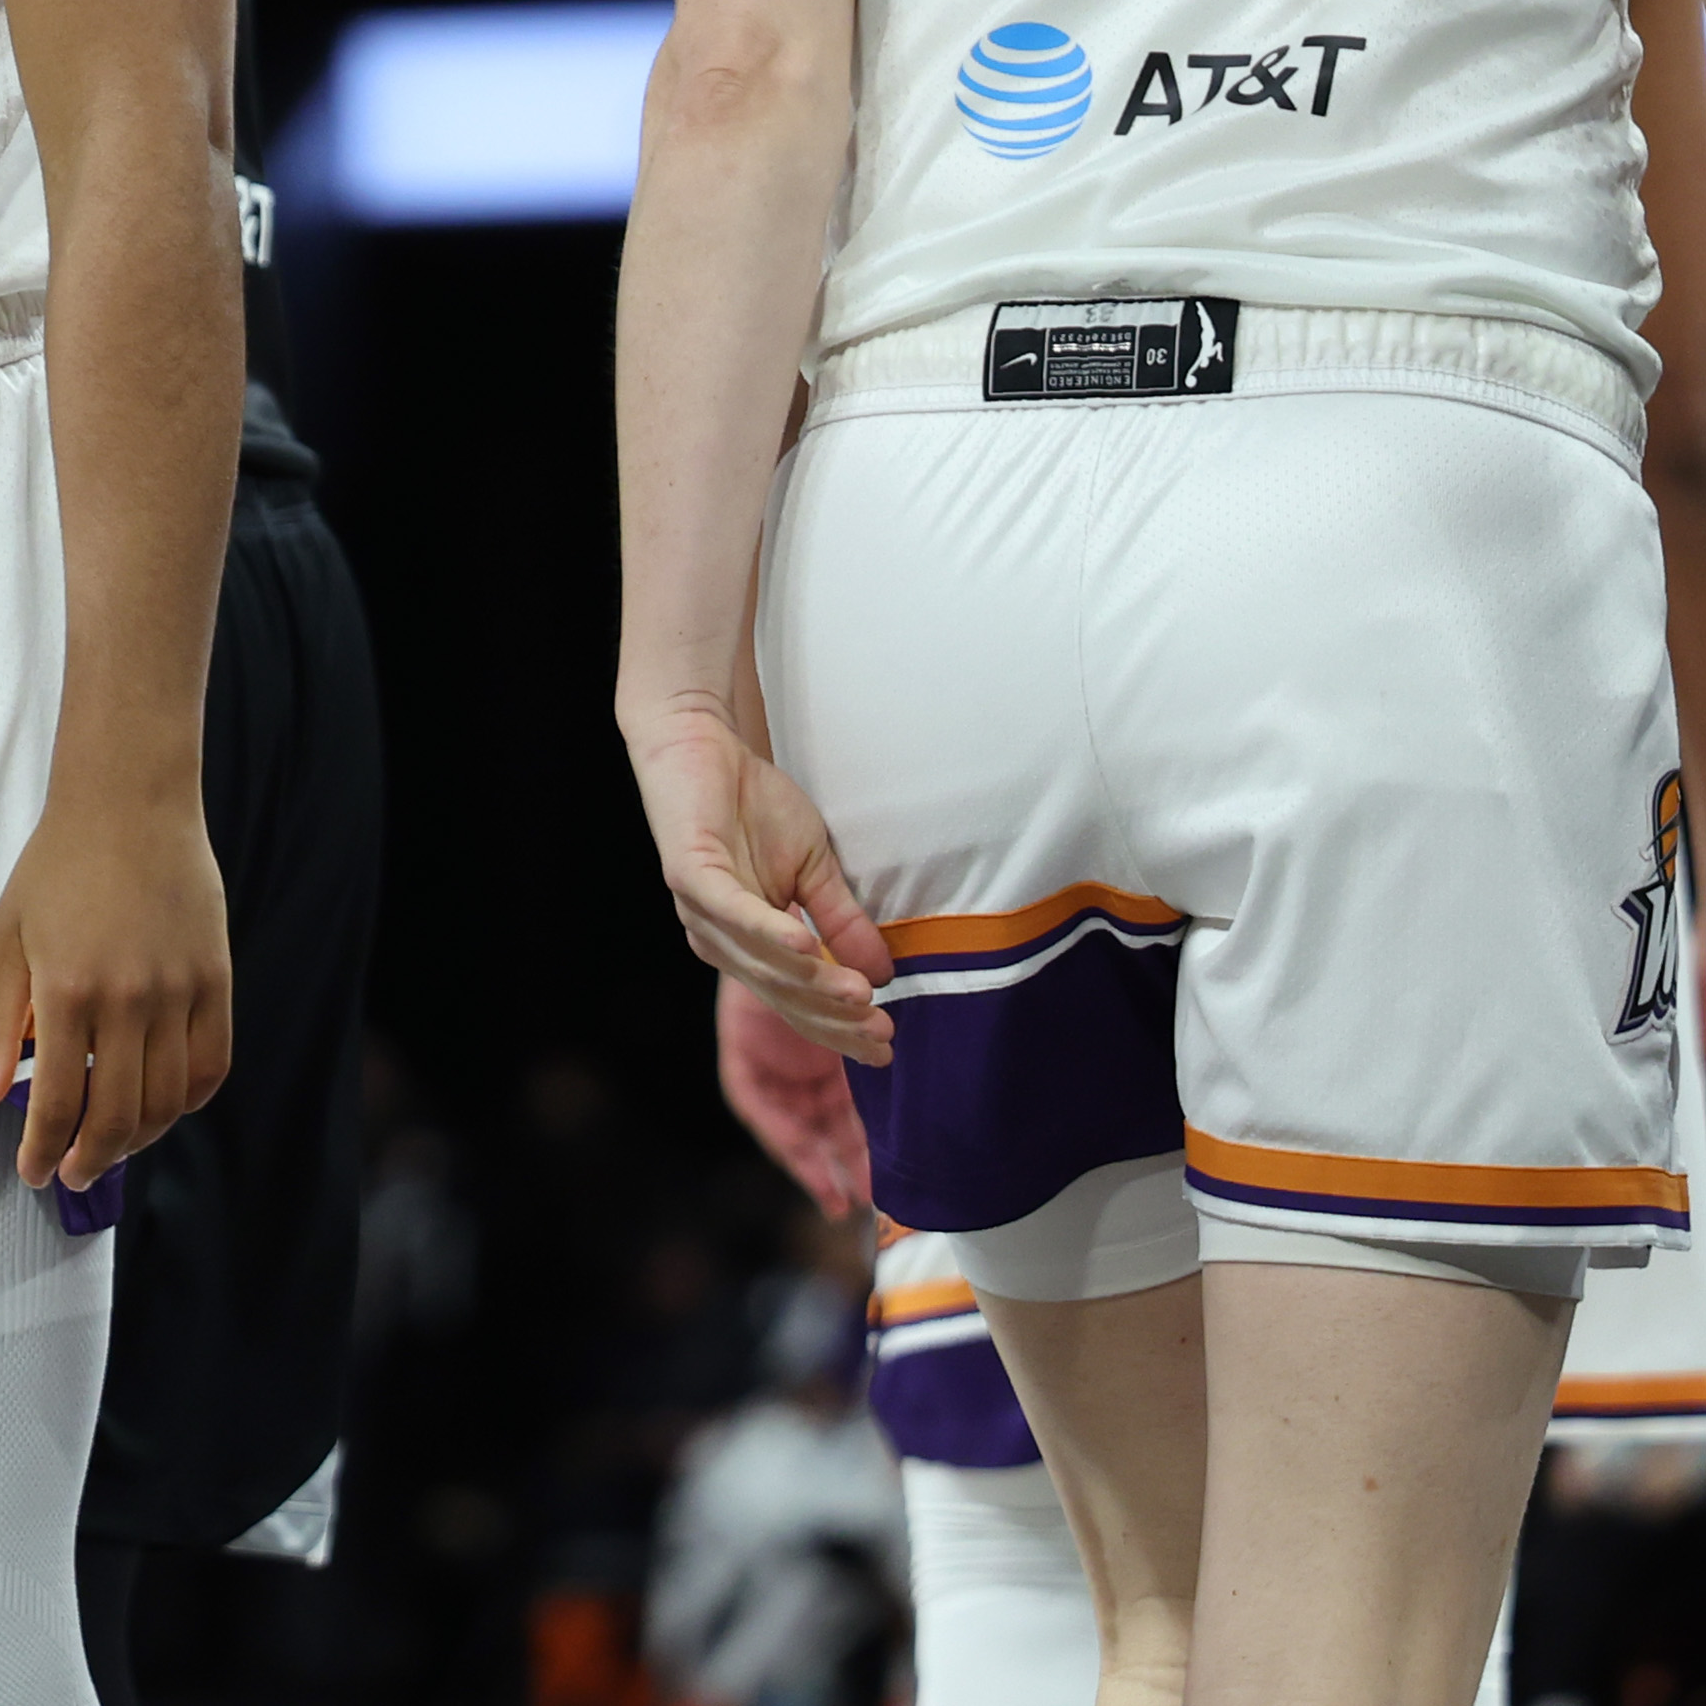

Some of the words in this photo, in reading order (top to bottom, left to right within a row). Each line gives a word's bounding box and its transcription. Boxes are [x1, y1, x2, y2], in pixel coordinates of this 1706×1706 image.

[1113, 34, 1368, 137] AT&T
[1146, 348, 1168, 366] 30
[1048, 375, 1131, 388] ENGINEERED
